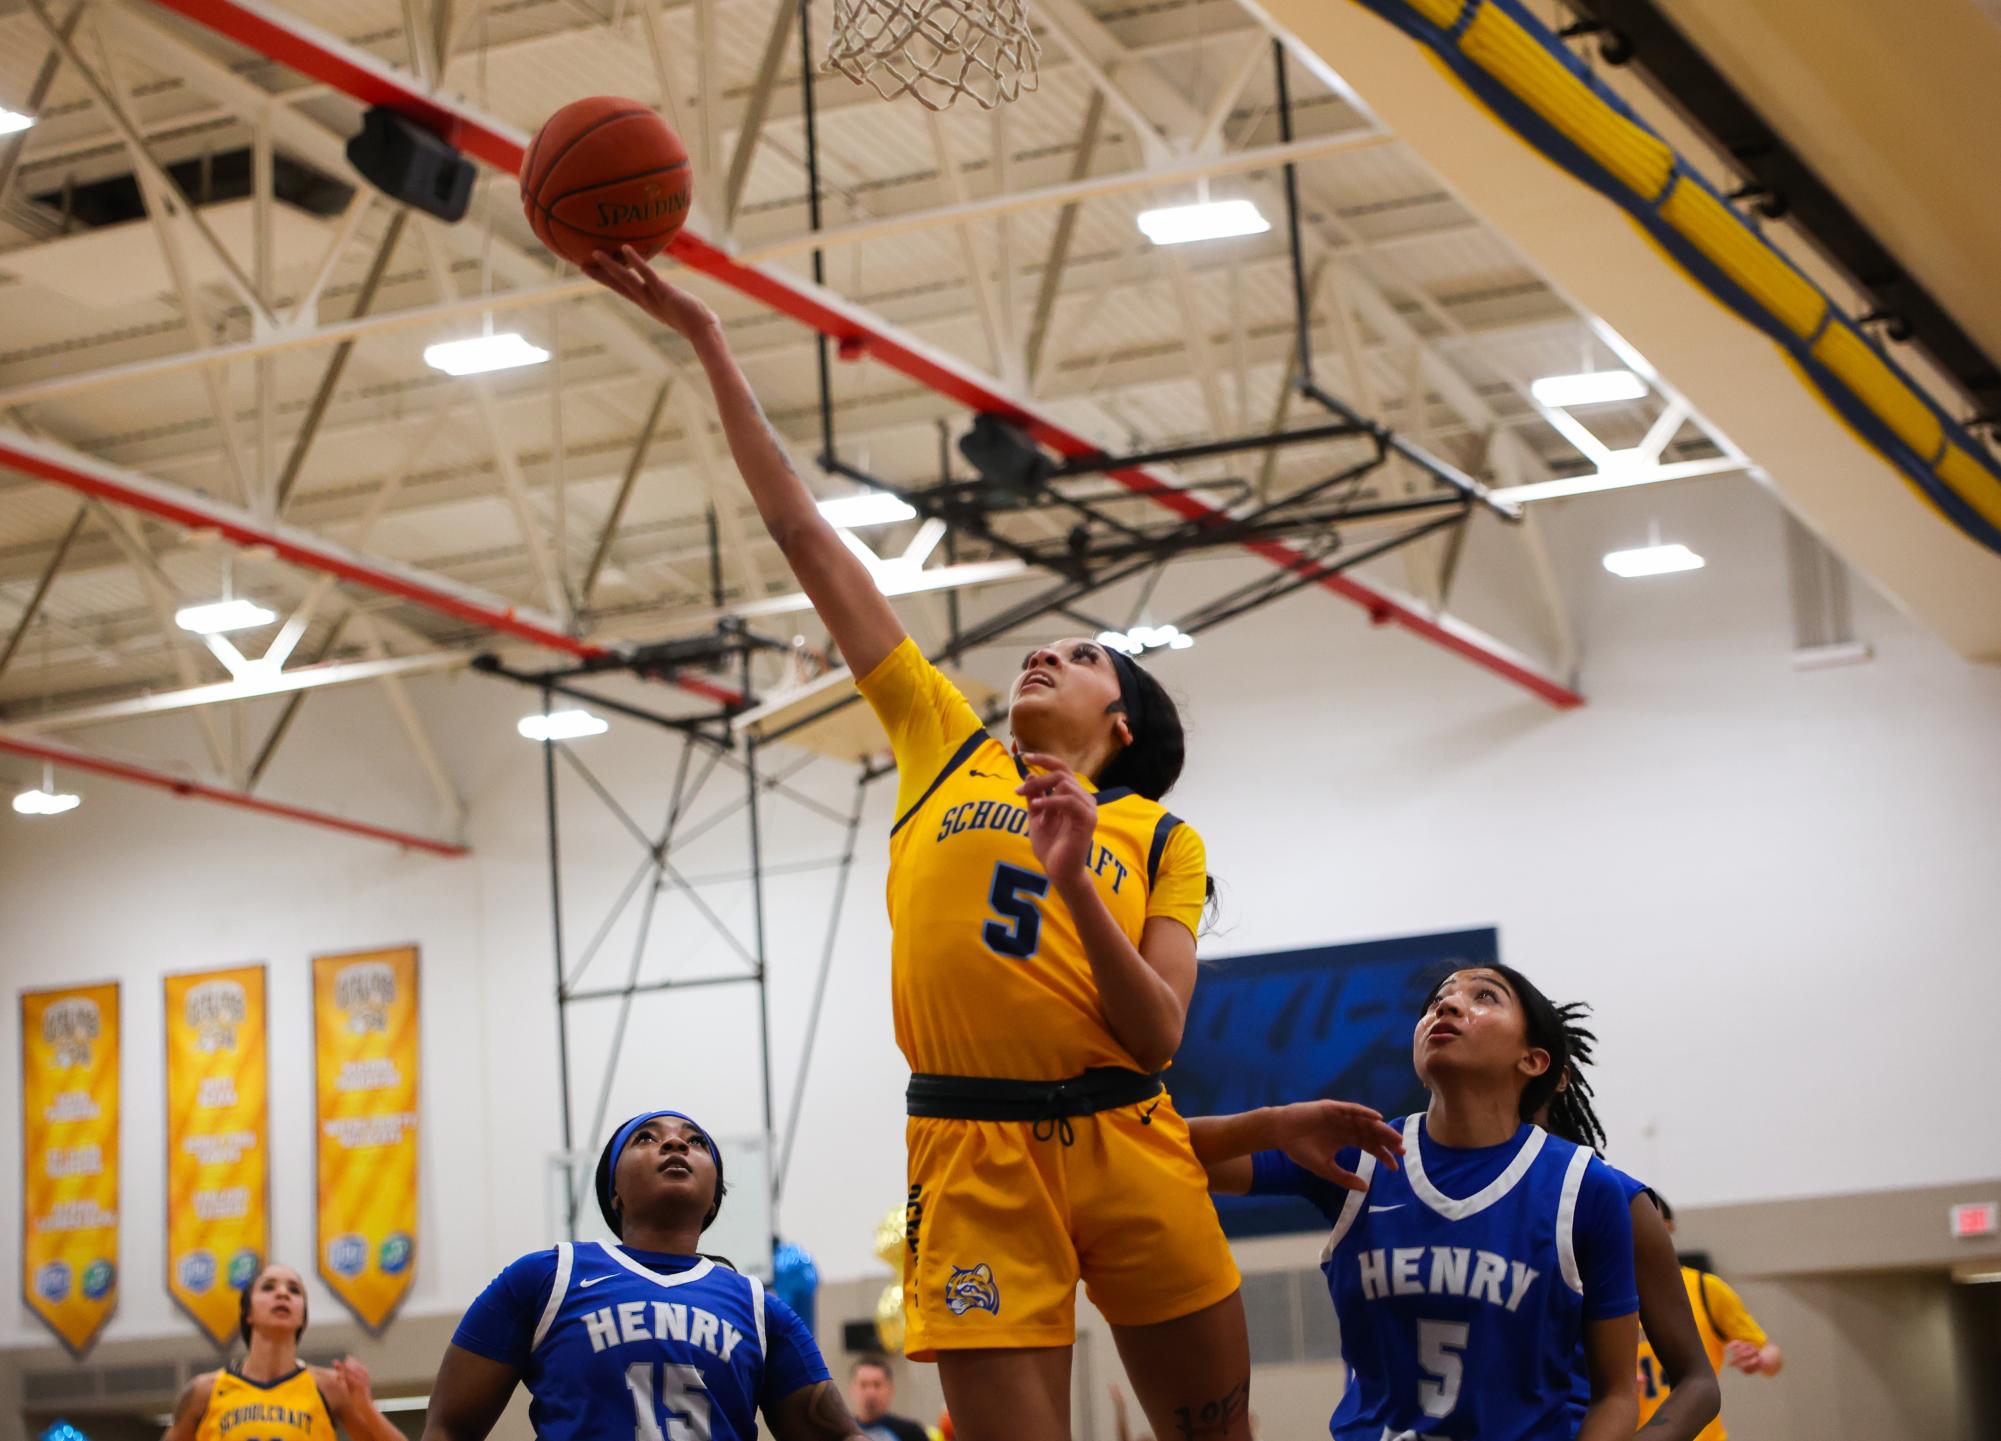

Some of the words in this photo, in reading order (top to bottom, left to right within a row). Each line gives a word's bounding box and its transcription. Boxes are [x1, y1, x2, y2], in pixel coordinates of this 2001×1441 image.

[596, 188, 688, 229] SPALDIN
[936, 800, 1128, 895] SCHOOAFT
[982, 859, 1050, 960] 5
[1358, 1246, 1540, 1313] HENRY
[580, 1301, 743, 1363] HENRY
[1417, 1318, 1470, 1419] 5
[625, 1362, 712, 1441] 15
